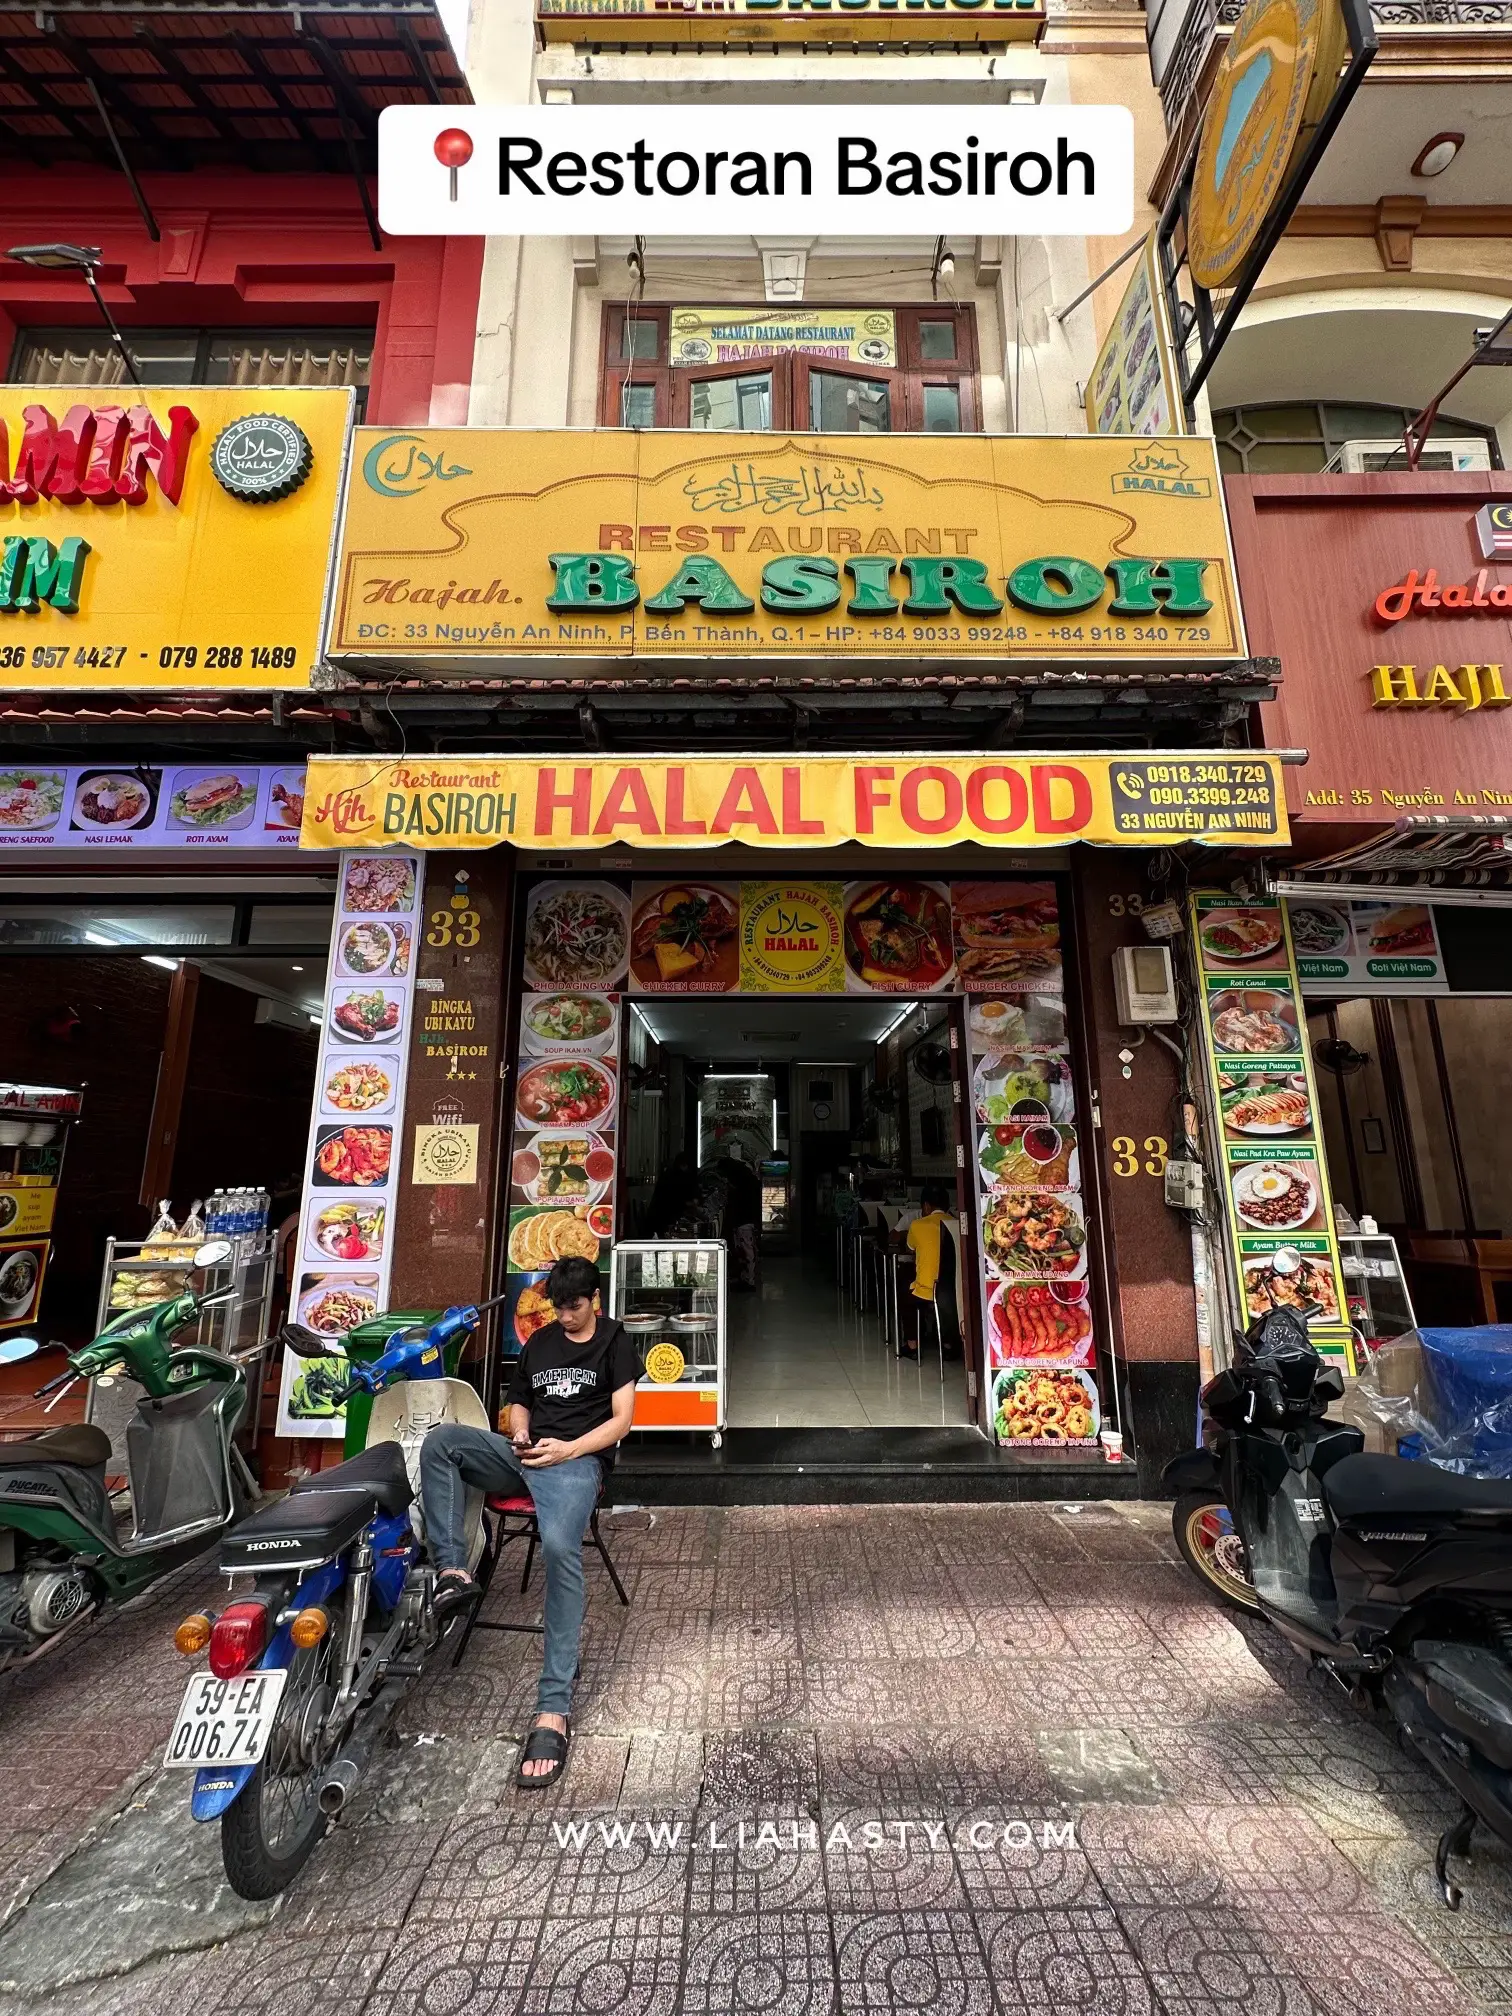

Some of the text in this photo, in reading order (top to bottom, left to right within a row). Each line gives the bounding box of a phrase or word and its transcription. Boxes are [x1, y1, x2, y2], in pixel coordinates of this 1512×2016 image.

[711, 326, 856, 341] SELAMAT DATANG RESTAURANT
[219, 420, 297, 465] HALAL FOOD CERTIFIED
[231, 435, 284, 460] حلال
[0, 404, 200, 505] MIN
[236, 461, 276, 469] HALAL
[241, 477, 268, 485] 100%
[1123, 477, 1201, 496] HALAL
[600, 524, 978, 554] RESTAURANT
[545, 552, 1214, 617] BASIROH
[357, 624, 397, 639] ĐC:
[404, 625, 429, 639] 33
[435, 620, 516, 643] Nguyễn
[523, 625, 551, 639] An
[558, 625, 613, 642] Ninh,
[645, 623, 687, 641] Bến
[692, 624, 765, 643] Thành,
[826, 627, 862, 641] HP:
[869, 627, 906, 641] +84
[912, 627, 961, 641] 9033
[967, 627, 1028, 641] 99248
[1047, 627, 1083, 642] +84
[1089, 627, 1127, 642] 918
[1133, 627, 1169, 642] 340
[1174, 627, 1211, 642] 729
[31, 646, 70, 668] 957
[73, 646, 128, 668] 4427
[159, 646, 198, 669] 079
[204, 646, 243, 669] 288
[251, 646, 297, 669] 1489
[1367, 664, 1512, 711] HAJI
[389, 768, 501, 789] Restaurant
[1146, 765, 1267, 783] 0918.340.729
[533, 765, 1094, 836] HALAL FOOD
[1149, 787, 1270, 805] 090.3399.248
[1304, 790, 1345, 806] Add:
[1350, 790, 1373, 805] 35
[1380, 785, 1445, 809] Nguyễn
[1452, 790, 1478, 805] An
[383, 792, 517, 836] BASIROH
[1120, 807, 1272, 829] 33 NGUYỄN AN NINH
[19, 836, 54, 844] SAEFOOD
[744, 891, 840, 946] RESTAURANT HAJAH BASIROH
[426, 911, 481, 947] 33
[764, 937, 820, 951] HALAL
[1302, 963, 1320, 974] Việt
[1322, 964, 1344, 972] Nam
[1371, 963, 1432, 974] Roti Việt Nam
[533, 982, 614, 991] PHO DAGING VN
[642, 981, 726, 991] CHICKEN CURRY
[871, 981, 933, 991] FISH CURRY
[964, 981, 1056, 991] BURGER CHICKEN
[1230, 979, 1267, 987] Roti Canai
[424, 1016, 476, 1031] UBI KAYU
[1241, 1062, 1267, 1070] Goreng
[1268, 1062, 1296, 1070] Pattaya
[432, 1114, 463, 1126] Wifi
[1111, 1136, 1169, 1177] 33
[1233, 1150, 1311, 1158] Nasi Pad Kra Paw Ayam
[1252, 1241, 1274, 1250] Ayam
[1299, 1241, 1317, 1249] Milk
[531, 1367, 597, 1389] AMERICAN
[543, 1382, 582, 1398] DREAM
[999, 1438, 1032, 1446] SOTONG
[1032, 1438, 1066, 1446] GORENG
[246, 1539, 302, 1552] HONDA
[195, 1679, 268, 1716] 59-EA
[172, 1717, 264, 1760] 006.74
[198, 1781, 235, 1792] HONDA
